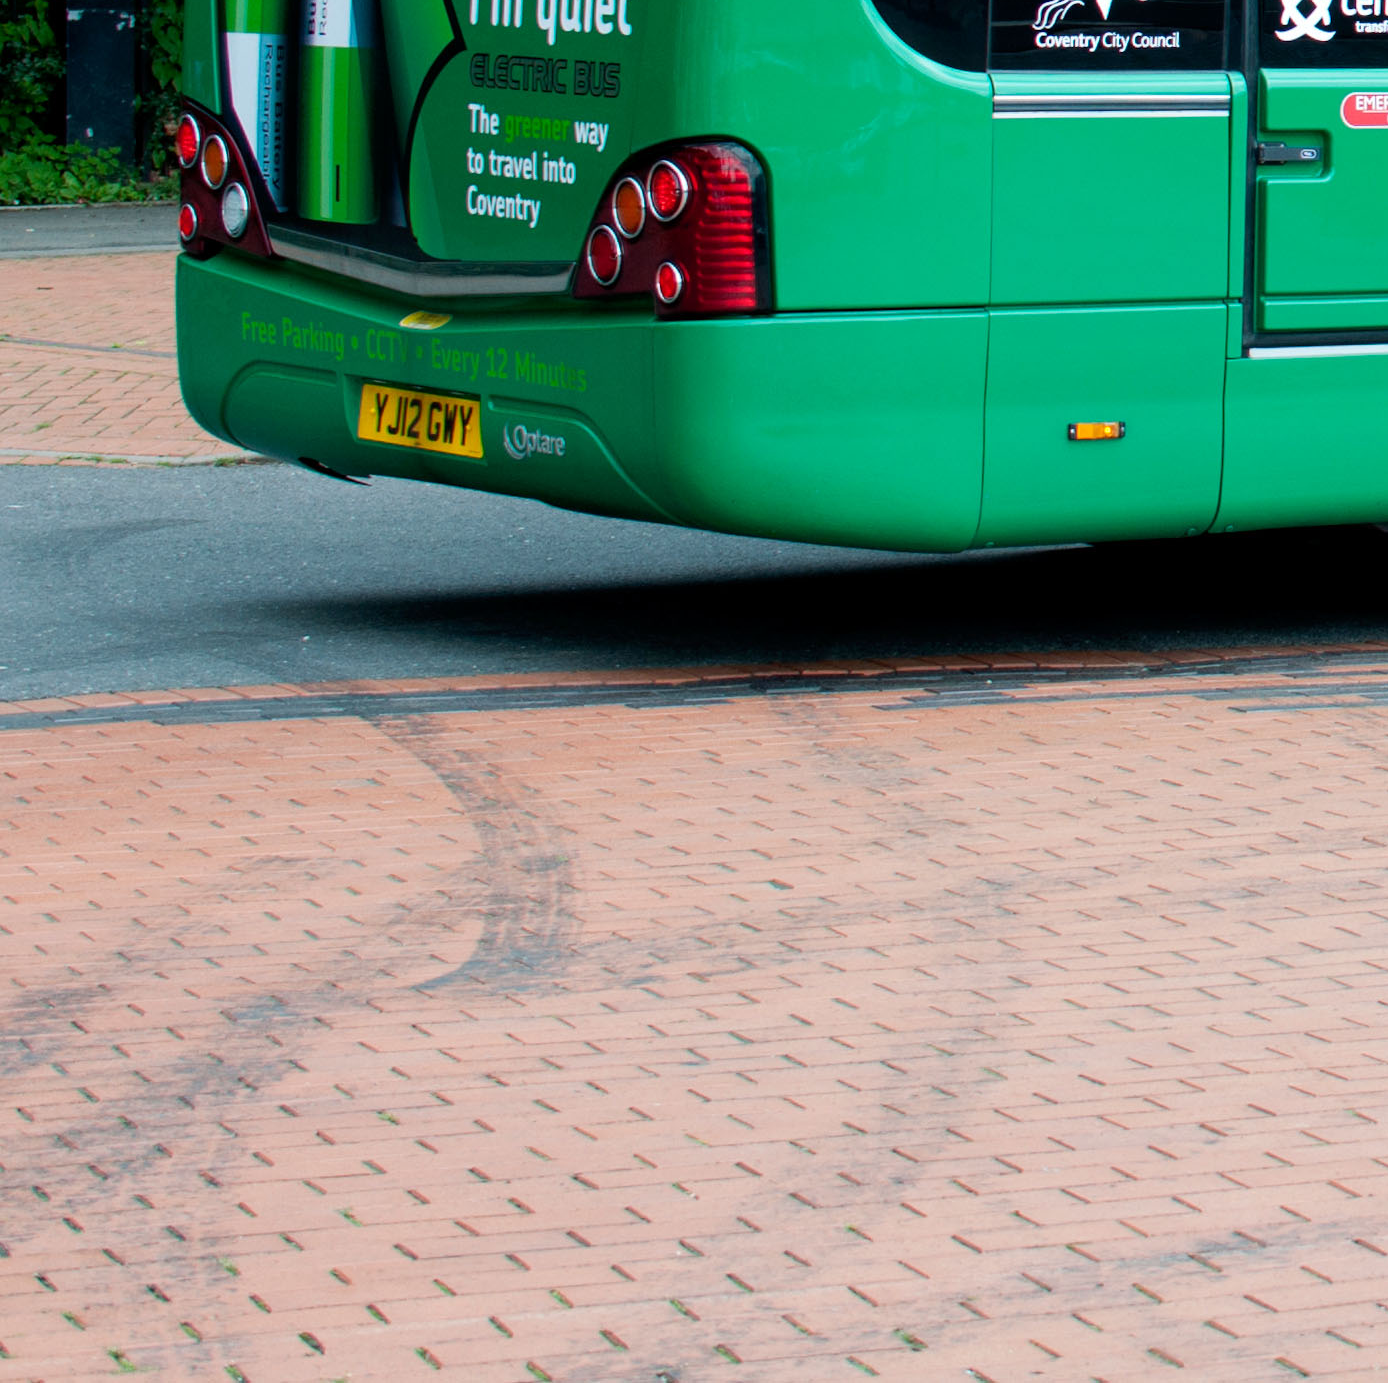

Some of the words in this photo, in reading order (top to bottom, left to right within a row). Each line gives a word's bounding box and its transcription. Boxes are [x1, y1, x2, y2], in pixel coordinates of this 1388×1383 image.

[1034, 31, 1100, 52] Coventry
[1102, 32, 1130, 52] City
[1132, 31, 1180, 48] Council
[470, 53, 568, 94] ELECTRIC
[574, 60, 621, 98] BUS
[262, 44, 273, 178] Rechargeabl
[467, 103, 499, 135] The
[504, 114, 570, 143] greener
[574, 121, 609, 152] way
[467, 147, 484, 174] to
[489, 151, 538, 181] travel
[542, 152, 576, 184] into
[466, 185, 541, 228] Coventry
[242, 312, 276, 346] Free
[282, 317, 344, 361] Parking
[431, 337, 480, 382] Every
[486, 347, 508, 379] 12
[515, 351, 588, 392] Minutes
[375, 393, 422, 439] YJ12
[427, 401, 473, 446] GWY
[513, 424, 565, 458] Optare
